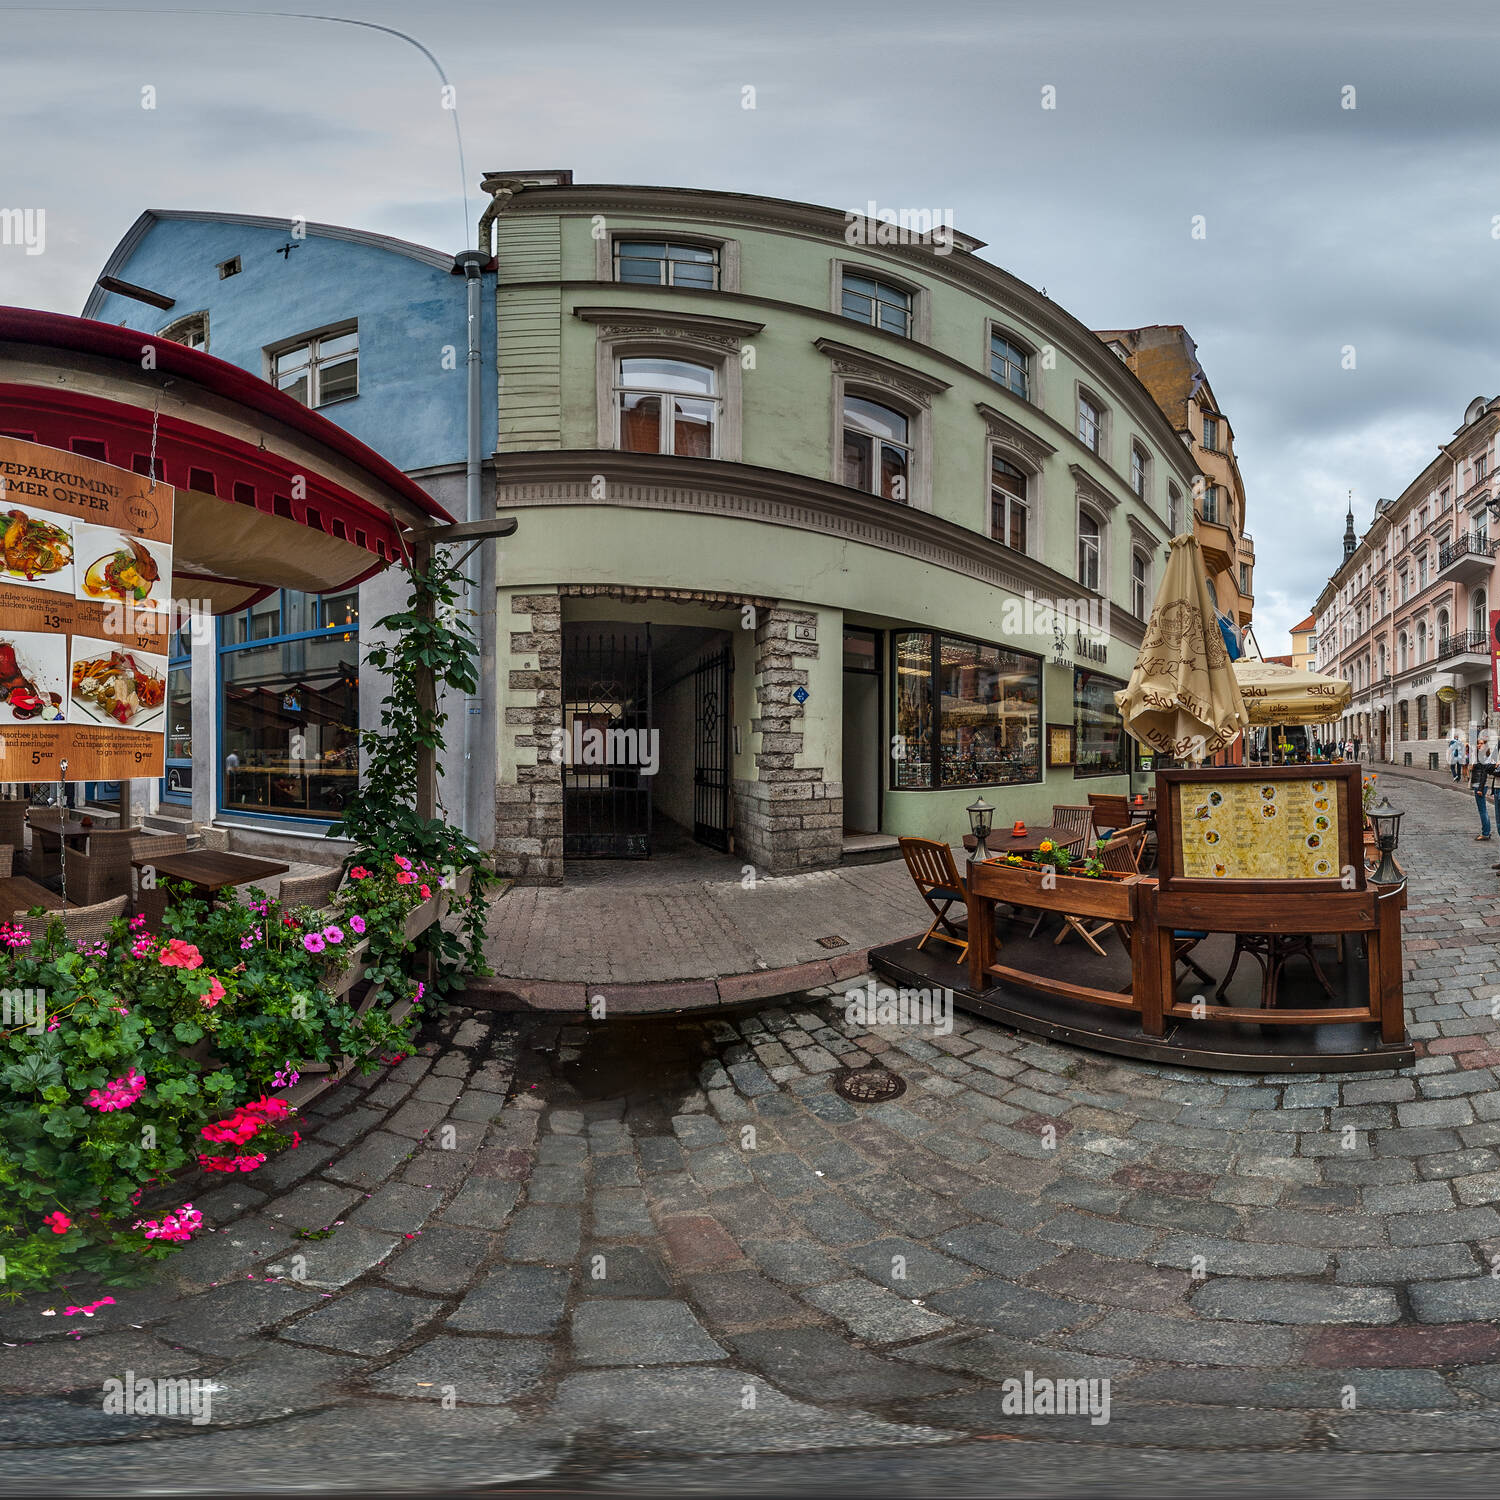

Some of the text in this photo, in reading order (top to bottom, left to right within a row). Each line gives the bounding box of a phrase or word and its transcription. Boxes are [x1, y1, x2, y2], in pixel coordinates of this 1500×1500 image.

[0, 477, 109, 512] MER OFFER
[804, 628, 809, 637] 6
[1240, 686, 1268, 697] saku
[1307, 684, 1335, 695] saku
[1143, 691, 1173, 709] saku
[1177, 693, 1203, 718] saku
[1209, 724, 1236, 752] saku
